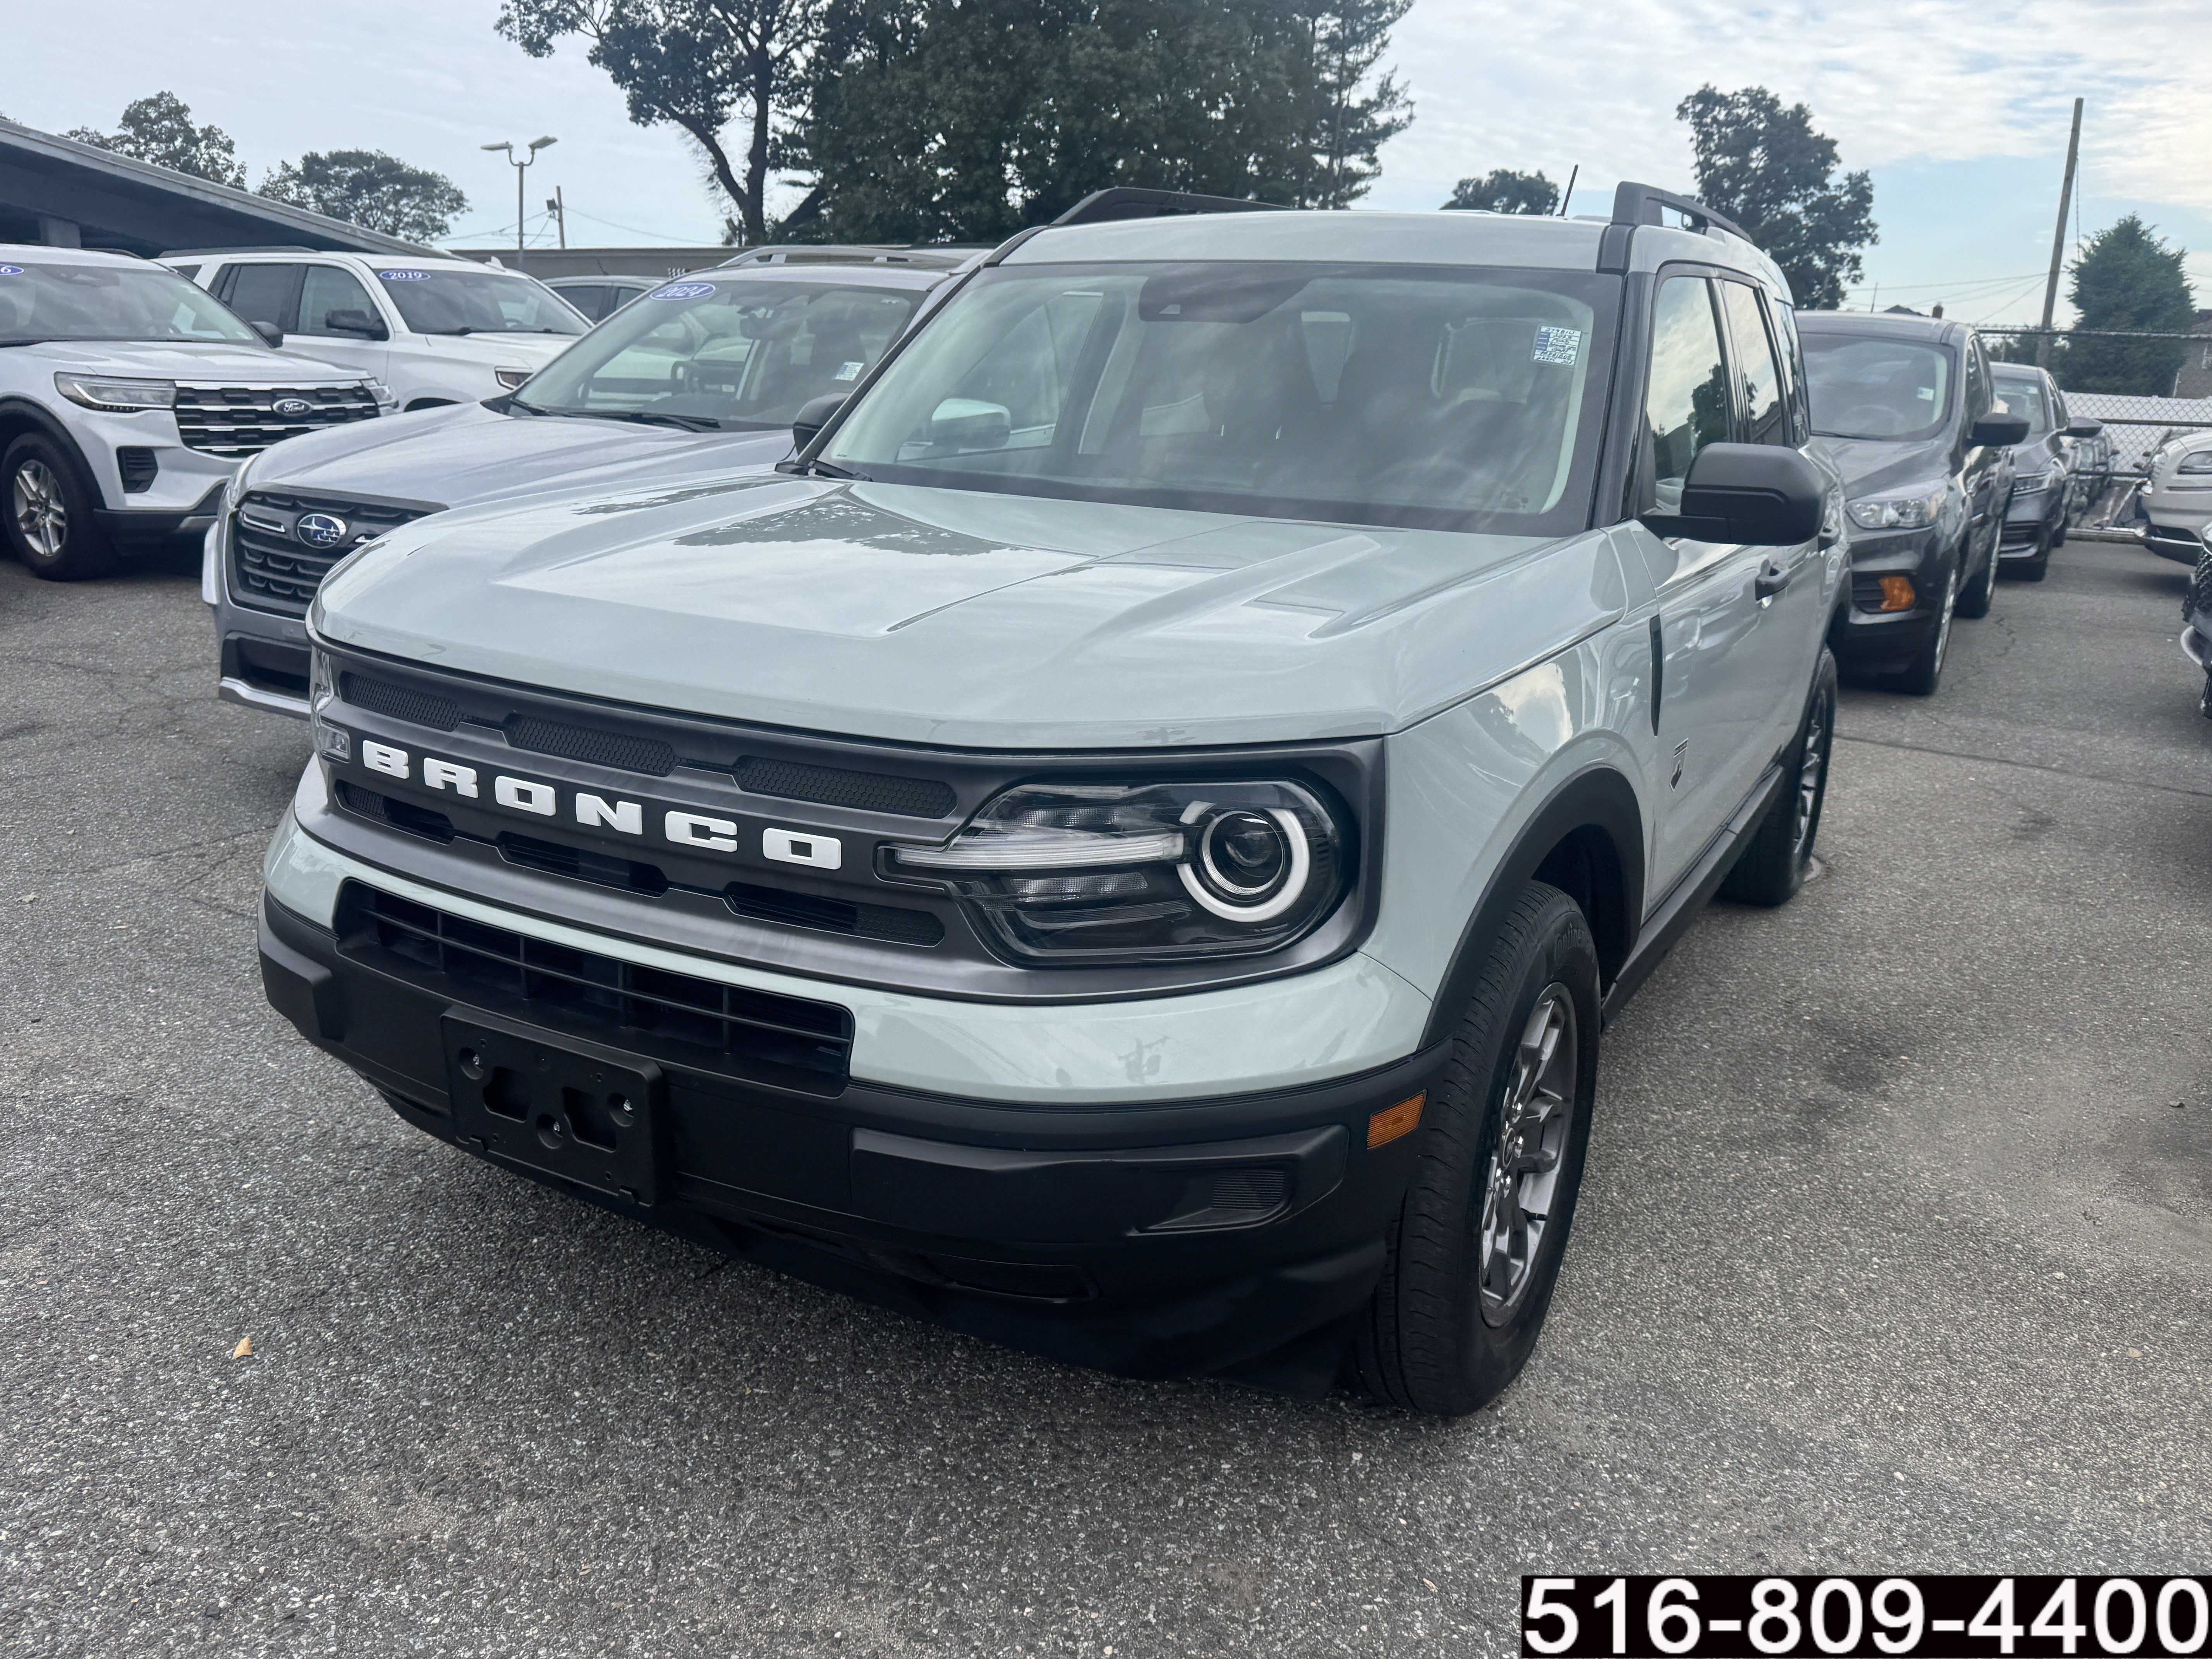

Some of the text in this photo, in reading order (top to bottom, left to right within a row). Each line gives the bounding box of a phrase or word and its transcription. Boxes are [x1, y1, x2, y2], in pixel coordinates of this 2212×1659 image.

[656, 286, 710, 297] 2024
[283, 402, 305, 412] Ford
[362, 740, 842, 869] BRONCO
